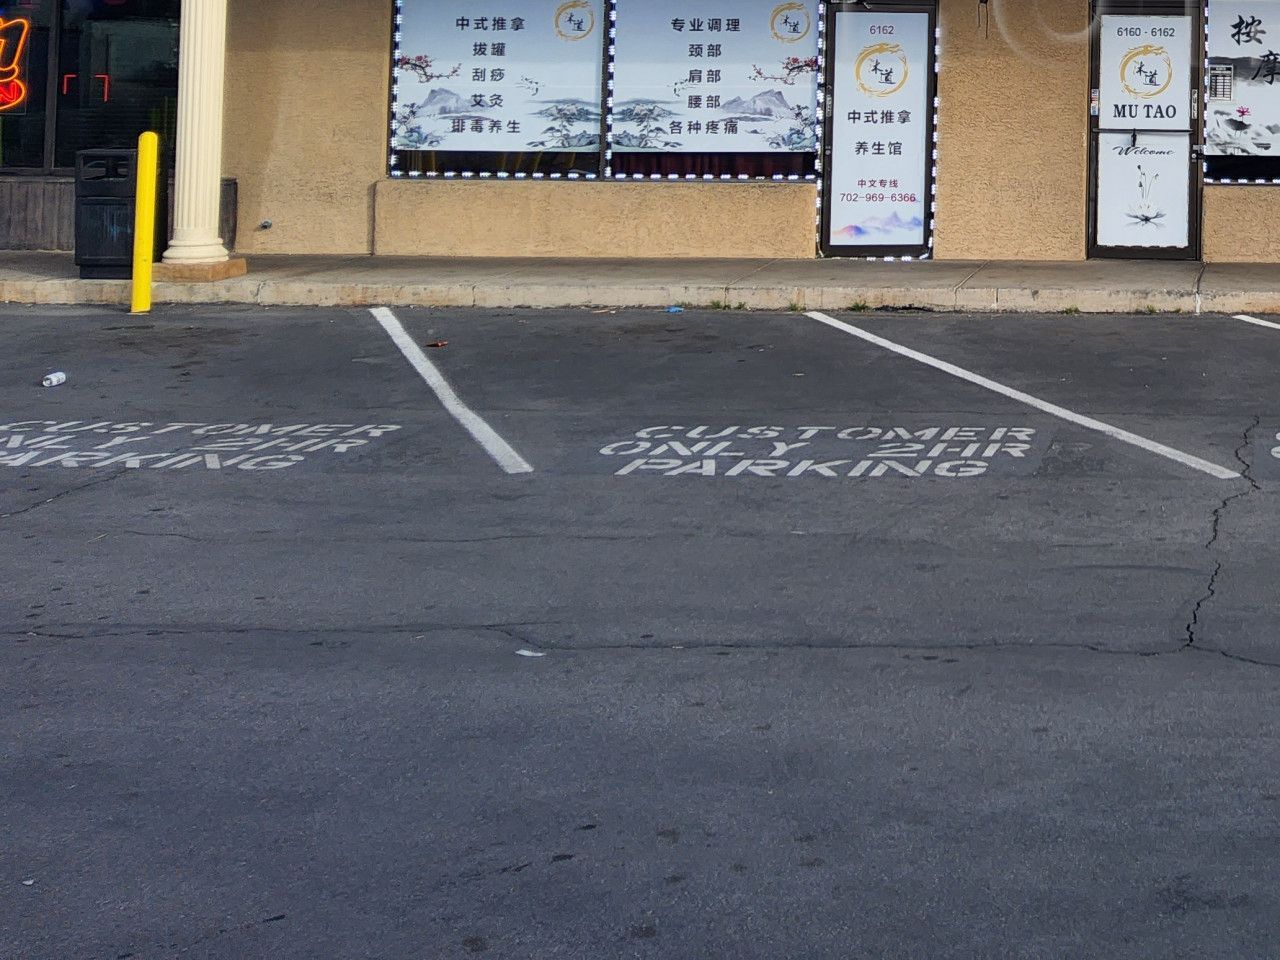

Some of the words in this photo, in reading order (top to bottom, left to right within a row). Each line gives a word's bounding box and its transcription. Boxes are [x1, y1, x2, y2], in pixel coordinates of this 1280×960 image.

[455, 16, 526, 31] 中式推拿
[671, 17, 741, 32] 专业调理
[869, 25, 895, 35] 6162
[1116, 27, 1141, 37] 6160
[1150, 27, 1176, 37] 6162
[472, 41, 507, 57] 拔罐
[688, 43, 722, 58] 颈部
[472, 67, 506, 82] 刮痧
[688, 69, 721, 84] 肩部
[470, 93, 504, 108] 艾灸
[687, 95, 721, 109] 腰部
[847, 109, 911, 124] 中式推拿
[1113, 104, 1139, 119] MU
[1143, 104, 1177, 119] TAO
[450, 119, 521, 134] 排毒养生
[668, 120, 739, 135] 各种疼痛
[854, 141, 903, 156] 养生馆
[1112, 145, 1175, 156] Welcome
[857, 179, 899, 189] 中文专线
[840, 193, 916, 202] 702-969-6366
[0, 420, 402, 438] CUSTOMER
[634, 425, 1038, 441] CUSTOMER
[0, 434, 152, 449] NLY
[191, 438, 371, 453] 2HR
[599, 440, 811, 458] ONLY
[867, 442, 1034, 458] 2HR
[0, 451, 305, 470] ARKING
[613, 458, 990, 478] PARKING
